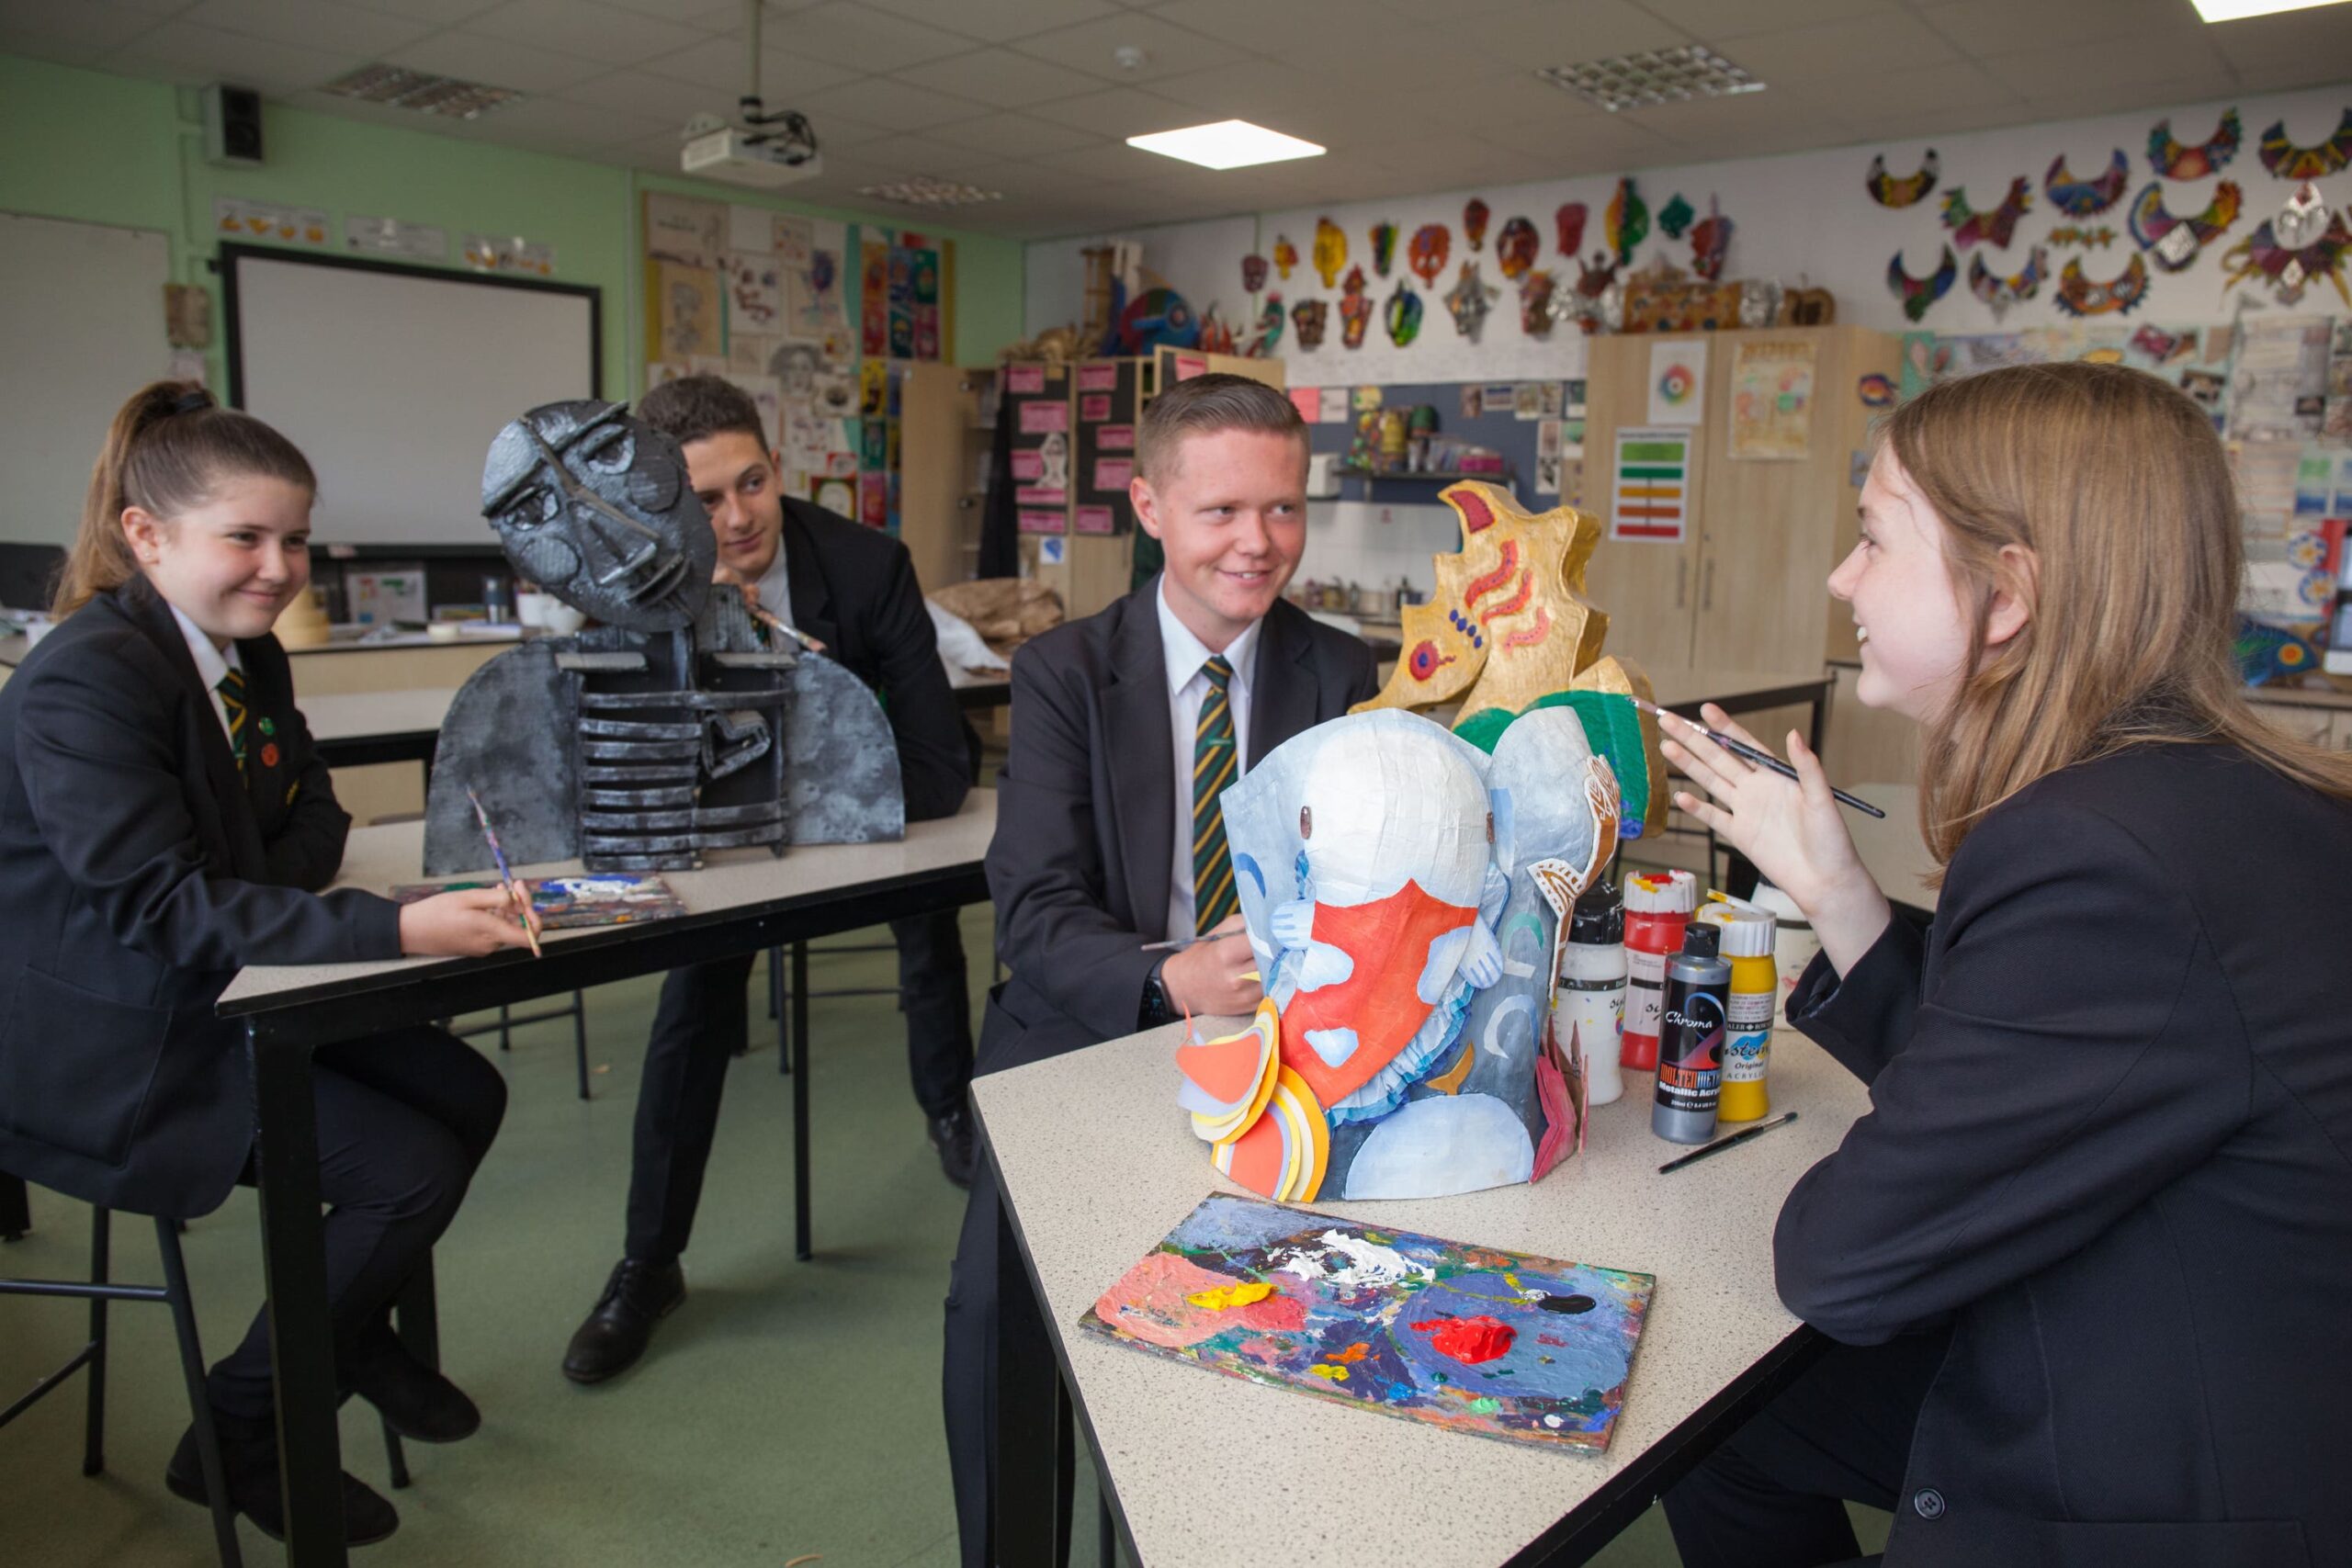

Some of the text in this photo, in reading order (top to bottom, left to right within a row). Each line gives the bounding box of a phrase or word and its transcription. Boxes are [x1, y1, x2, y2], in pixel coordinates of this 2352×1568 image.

[1666, 1010, 1713, 1028] Chroma
[1735, 1062, 1764, 1070] Original
[1658, 1080, 1698, 1097] Metallic
